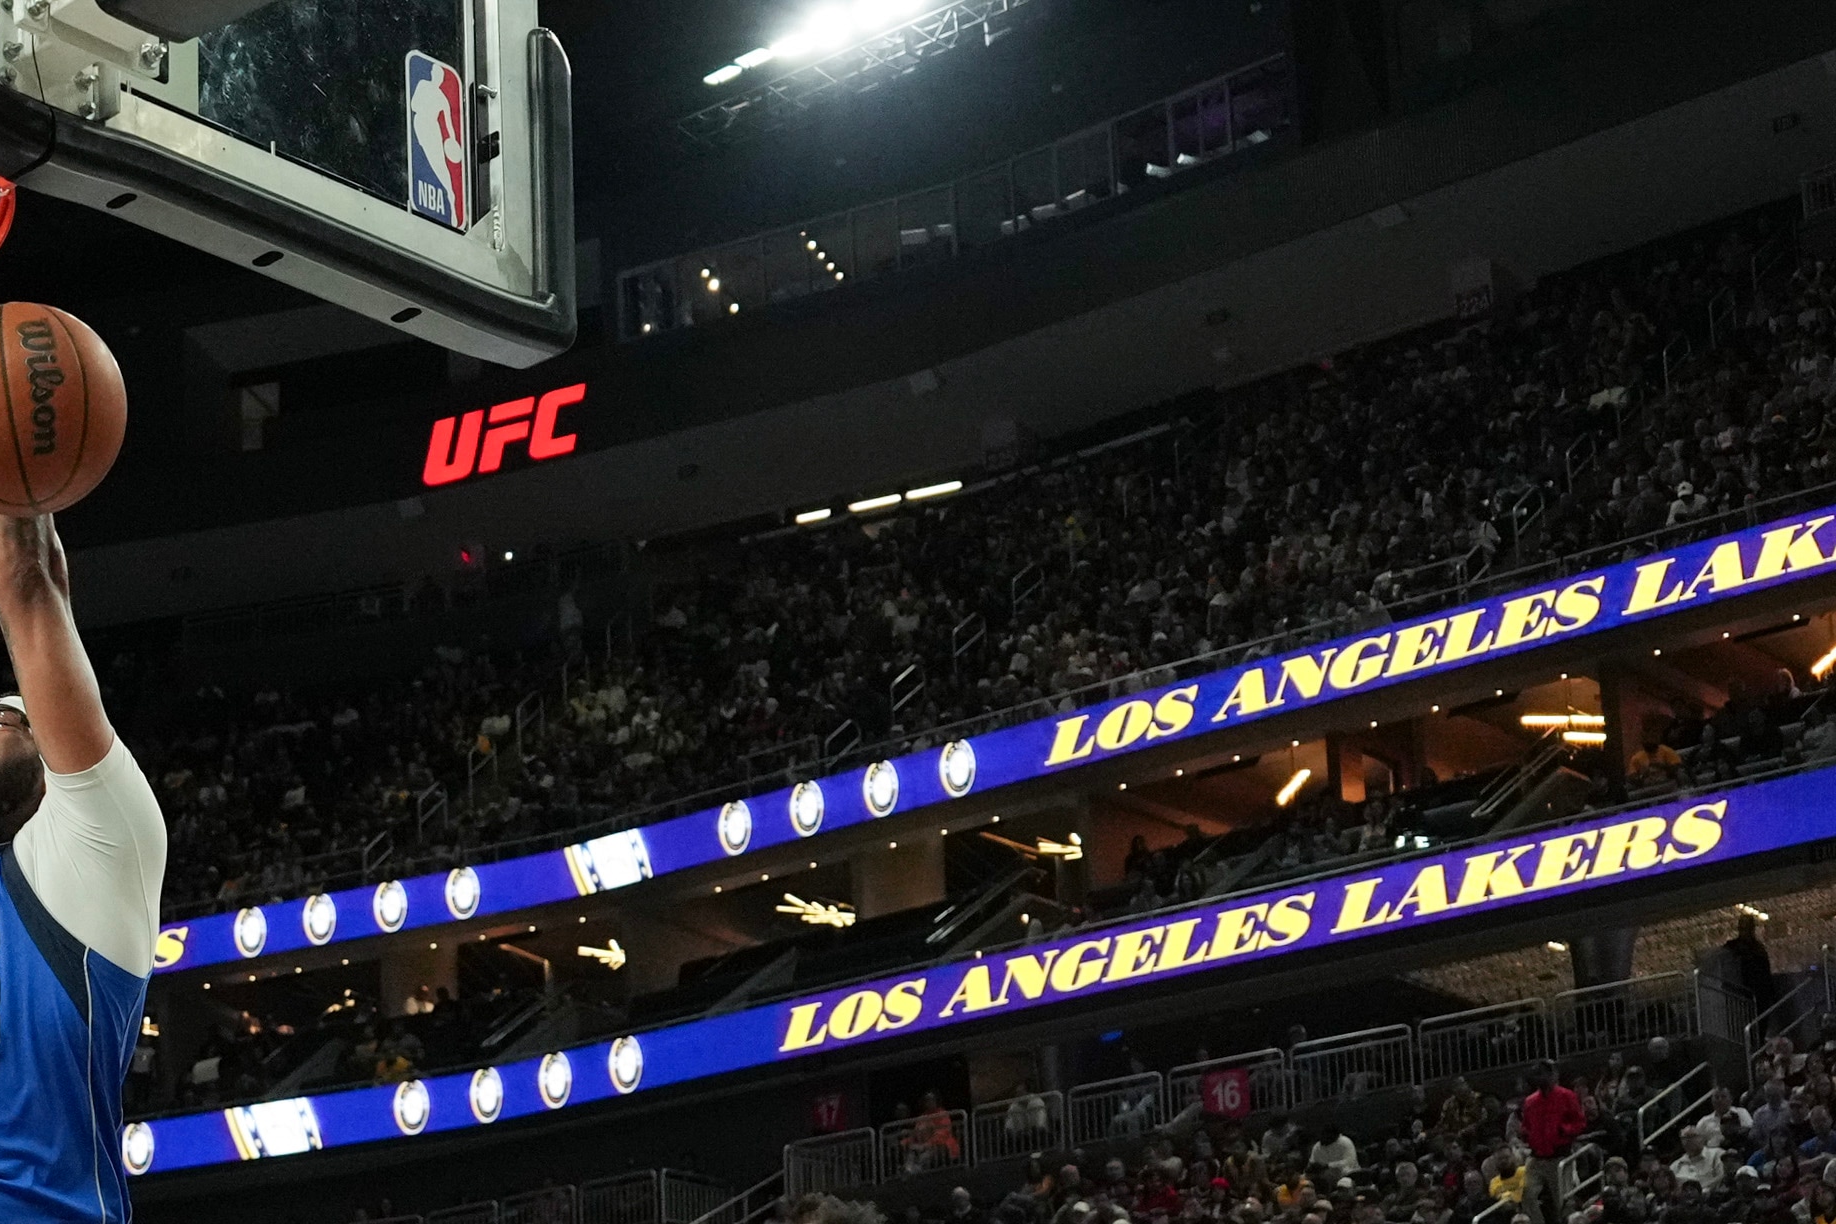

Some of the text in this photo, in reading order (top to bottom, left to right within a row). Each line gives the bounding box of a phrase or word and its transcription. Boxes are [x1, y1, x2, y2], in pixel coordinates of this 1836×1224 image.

[418, 179, 446, 216] NBA
[15, 317, 65, 456] Wilson
[422, 382, 587, 487] UFC
[1044, 514, 1836, 766] LOS ANGELES LAK
[778, 799, 1729, 1053] LOS ANGELES LAKERS
[1212, 1080, 1241, 1111] 16
